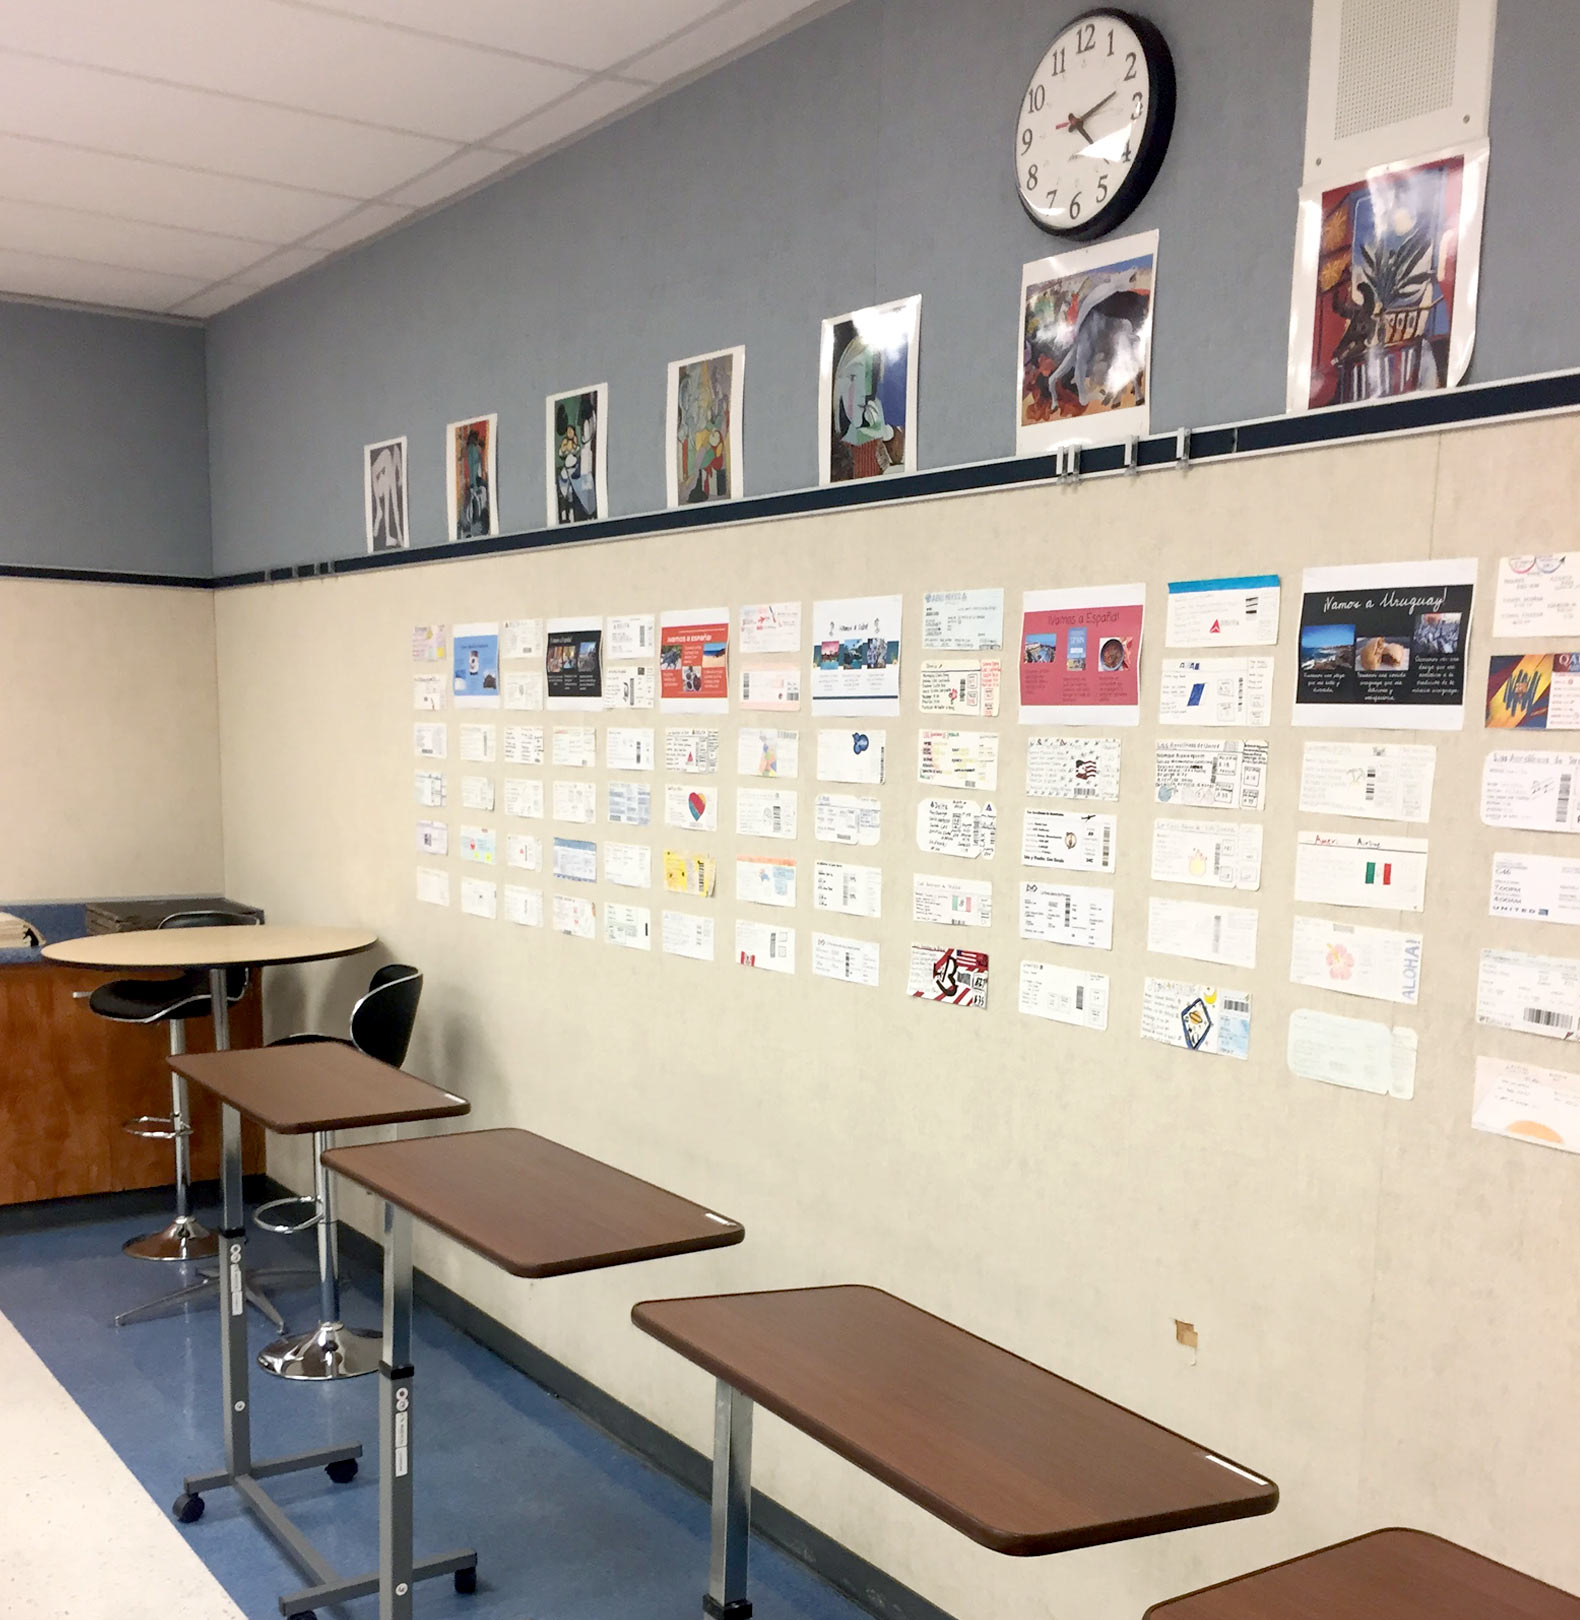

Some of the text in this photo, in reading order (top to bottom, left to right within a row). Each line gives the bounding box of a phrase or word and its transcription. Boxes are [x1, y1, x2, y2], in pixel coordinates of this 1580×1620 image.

[1076, 24, 1096, 54] 12
[1106, 29, 1114, 56] 1
[1051, 48, 1066, 76] 11
[1124, 53, 1137, 81] 2
[1028, 84, 1046, 114] 10
[1130, 92, 1143, 120] 3
[1021, 129, 1033, 156] 9
[1026, 164, 1038, 190] 8
[1096, 175, 1109, 203] 5
[1046, 189, 1057, 210] 7
[1069, 191, 1082, 219] 6
[1365, 600, 1375, 609] a
[1379, 587, 1447, 615] Uruguay!
[1400, 938, 1421, 1000] ALOHA!
